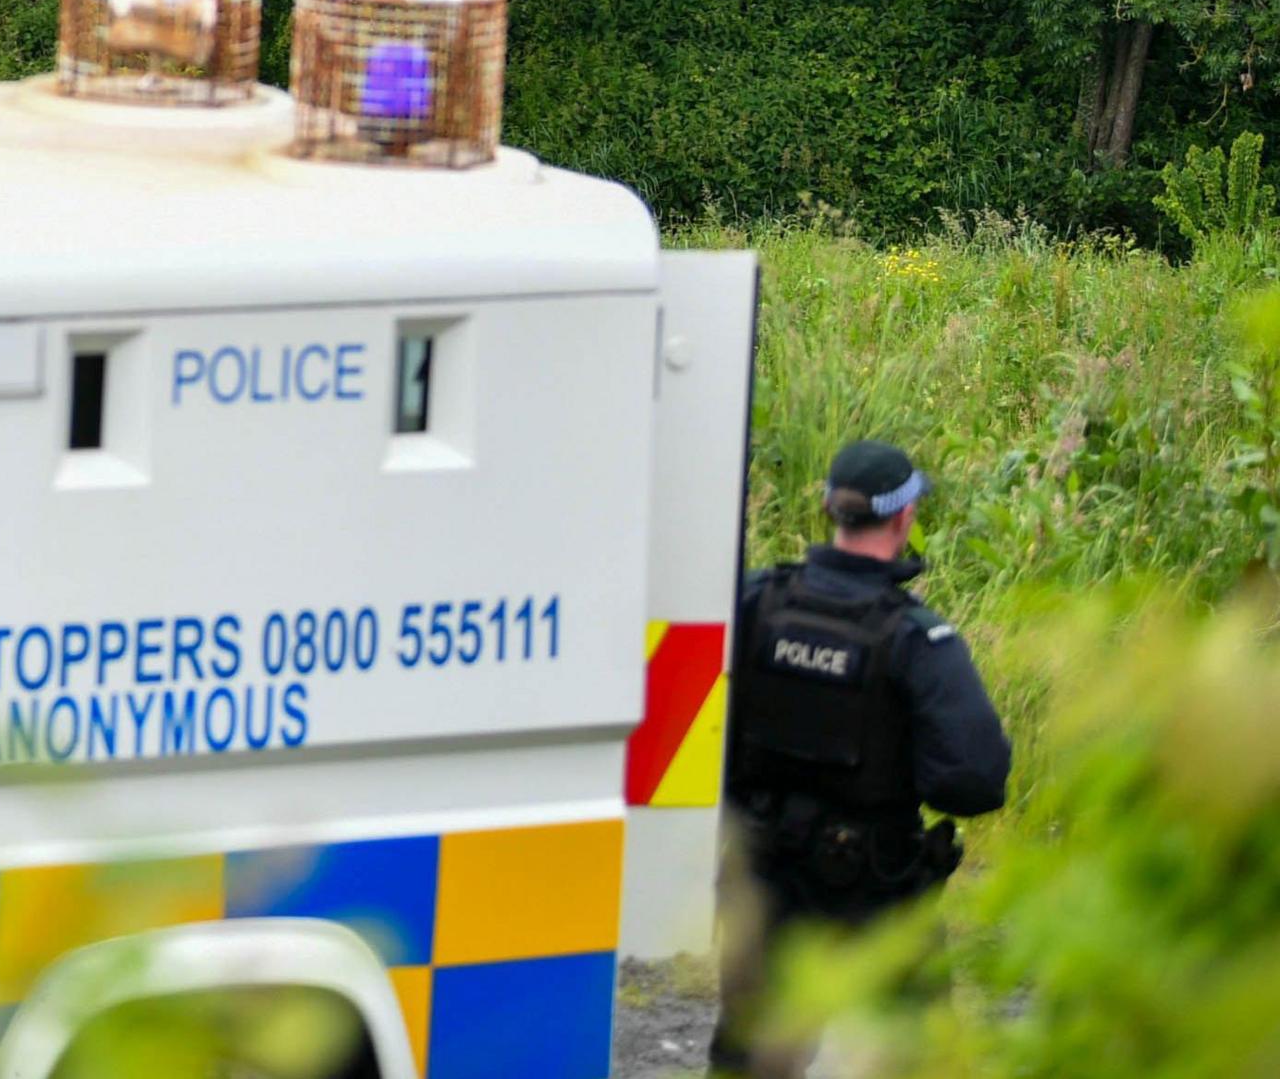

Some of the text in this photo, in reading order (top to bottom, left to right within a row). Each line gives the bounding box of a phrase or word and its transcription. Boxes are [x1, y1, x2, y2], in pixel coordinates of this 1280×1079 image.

[171, 343, 367, 405] POLICE
[262, 607, 379, 673] 0800
[396, 594, 561, 668] 555111
[773, 637, 849, 676] POLICE
